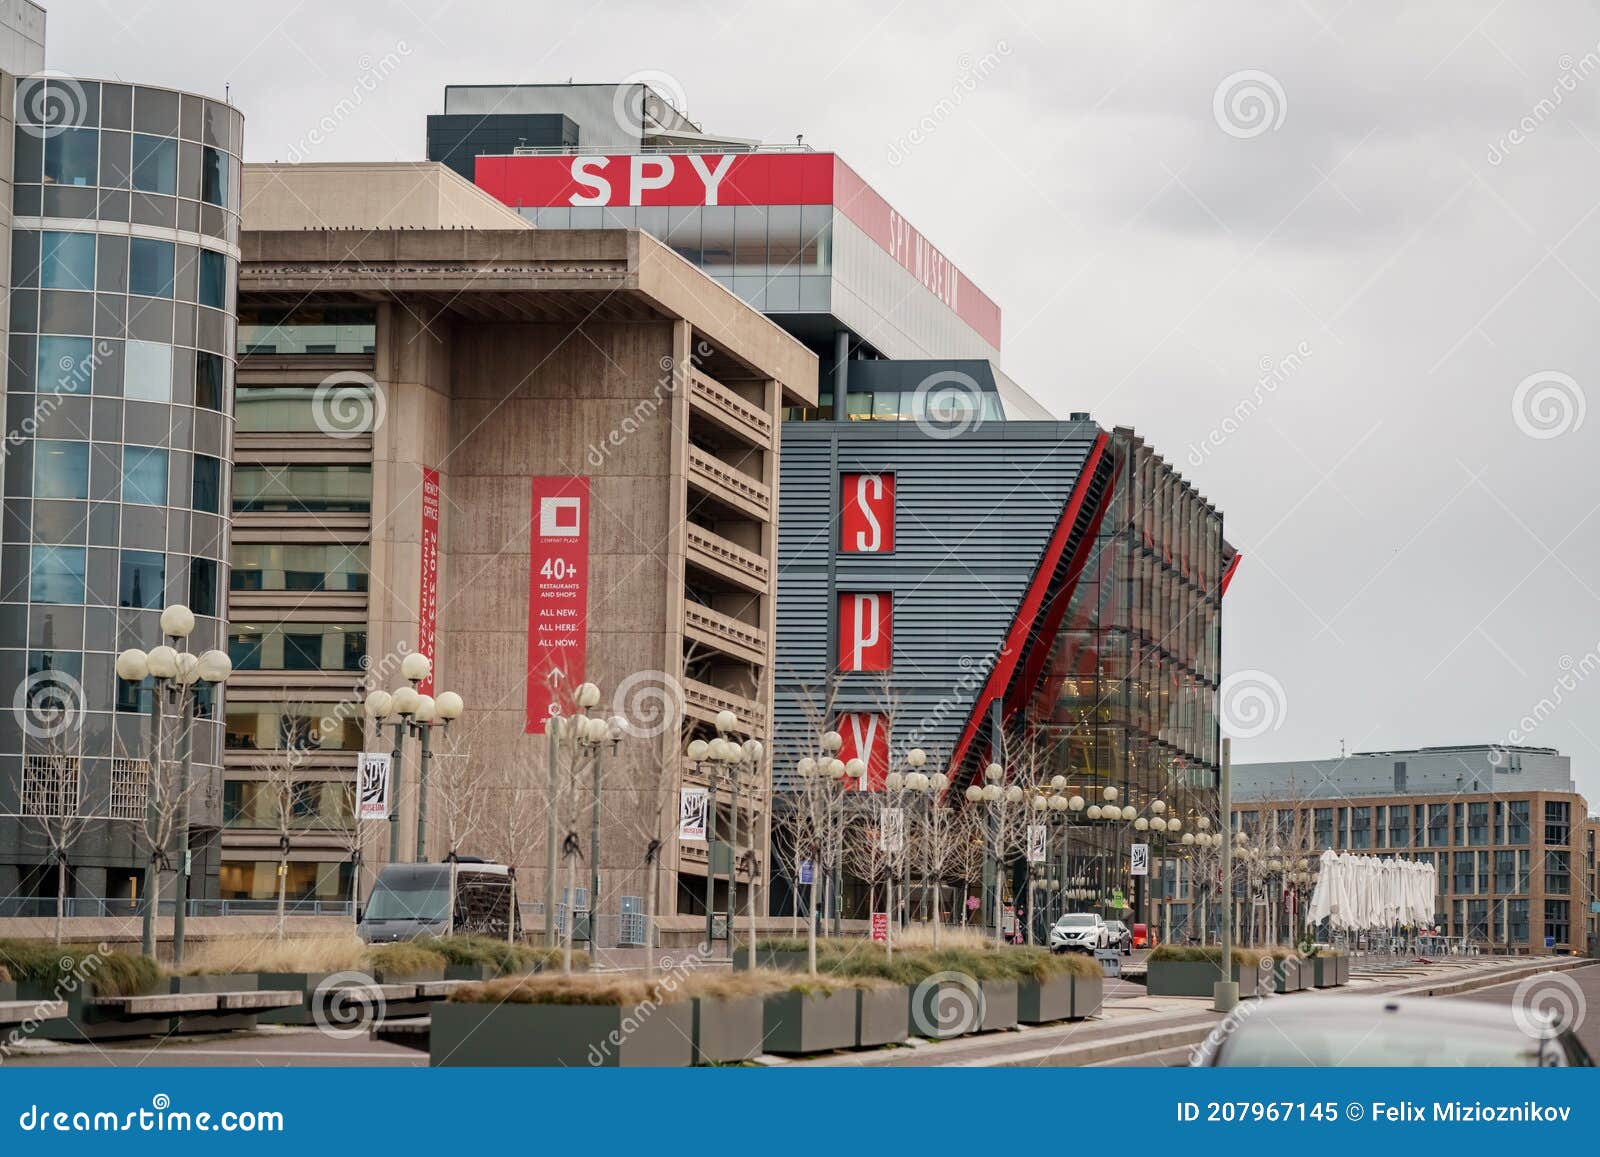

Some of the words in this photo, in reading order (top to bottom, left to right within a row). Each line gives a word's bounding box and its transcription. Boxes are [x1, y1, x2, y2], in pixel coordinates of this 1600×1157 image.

[568, 155, 737, 207] SPY
[890, 209, 910, 271] SPY
[915, 232, 958, 311] MUSEUM
[540, 557, 577, 580] 40+
[540, 609, 555, 617] ALL
[556, 609, 578, 617] NEW.
[538, 624, 553, 632] ALL
[555, 624, 579, 632] HERE.
[538, 639, 553, 647] ALL
[555, 639, 578, 647] NOW.
[363, 762, 387, 791] SPY
